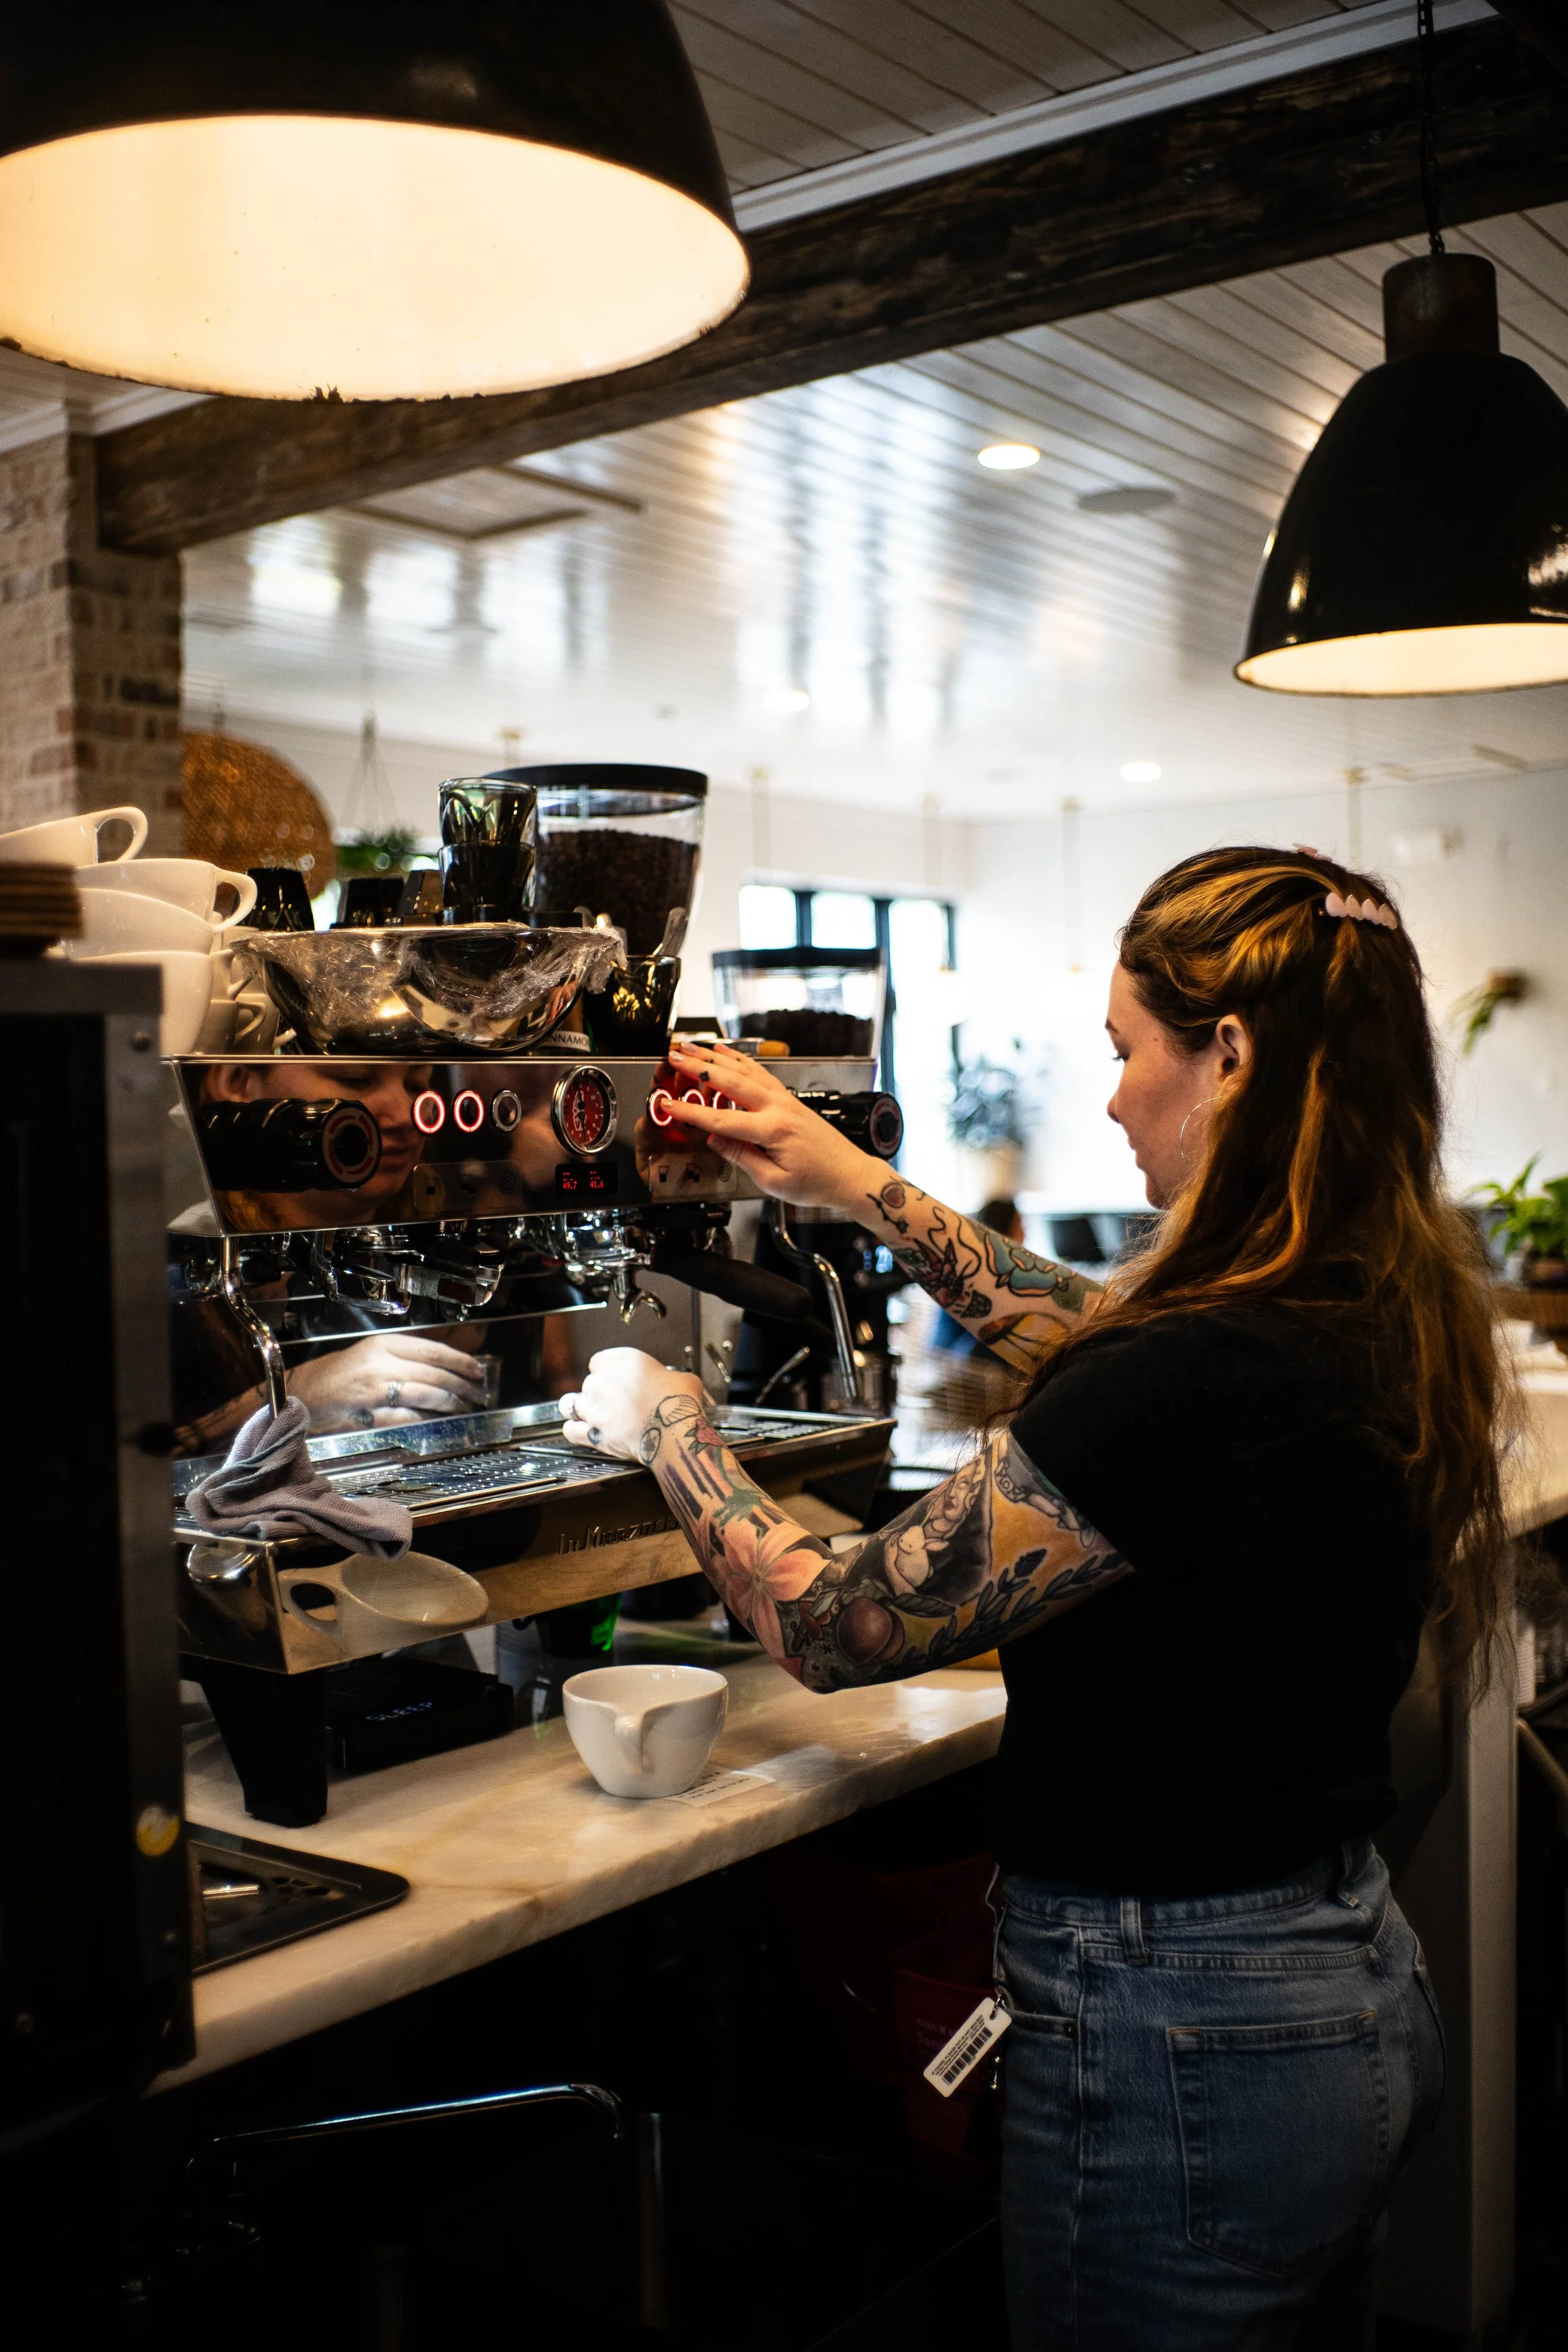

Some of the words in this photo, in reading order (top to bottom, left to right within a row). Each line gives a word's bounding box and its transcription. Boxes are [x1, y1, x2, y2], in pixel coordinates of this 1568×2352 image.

[546, 1033, 589, 1047] NNAMO
[563, 1181, 577, 1189] 49.7
[590, 1180, 604, 1188] 41.6
